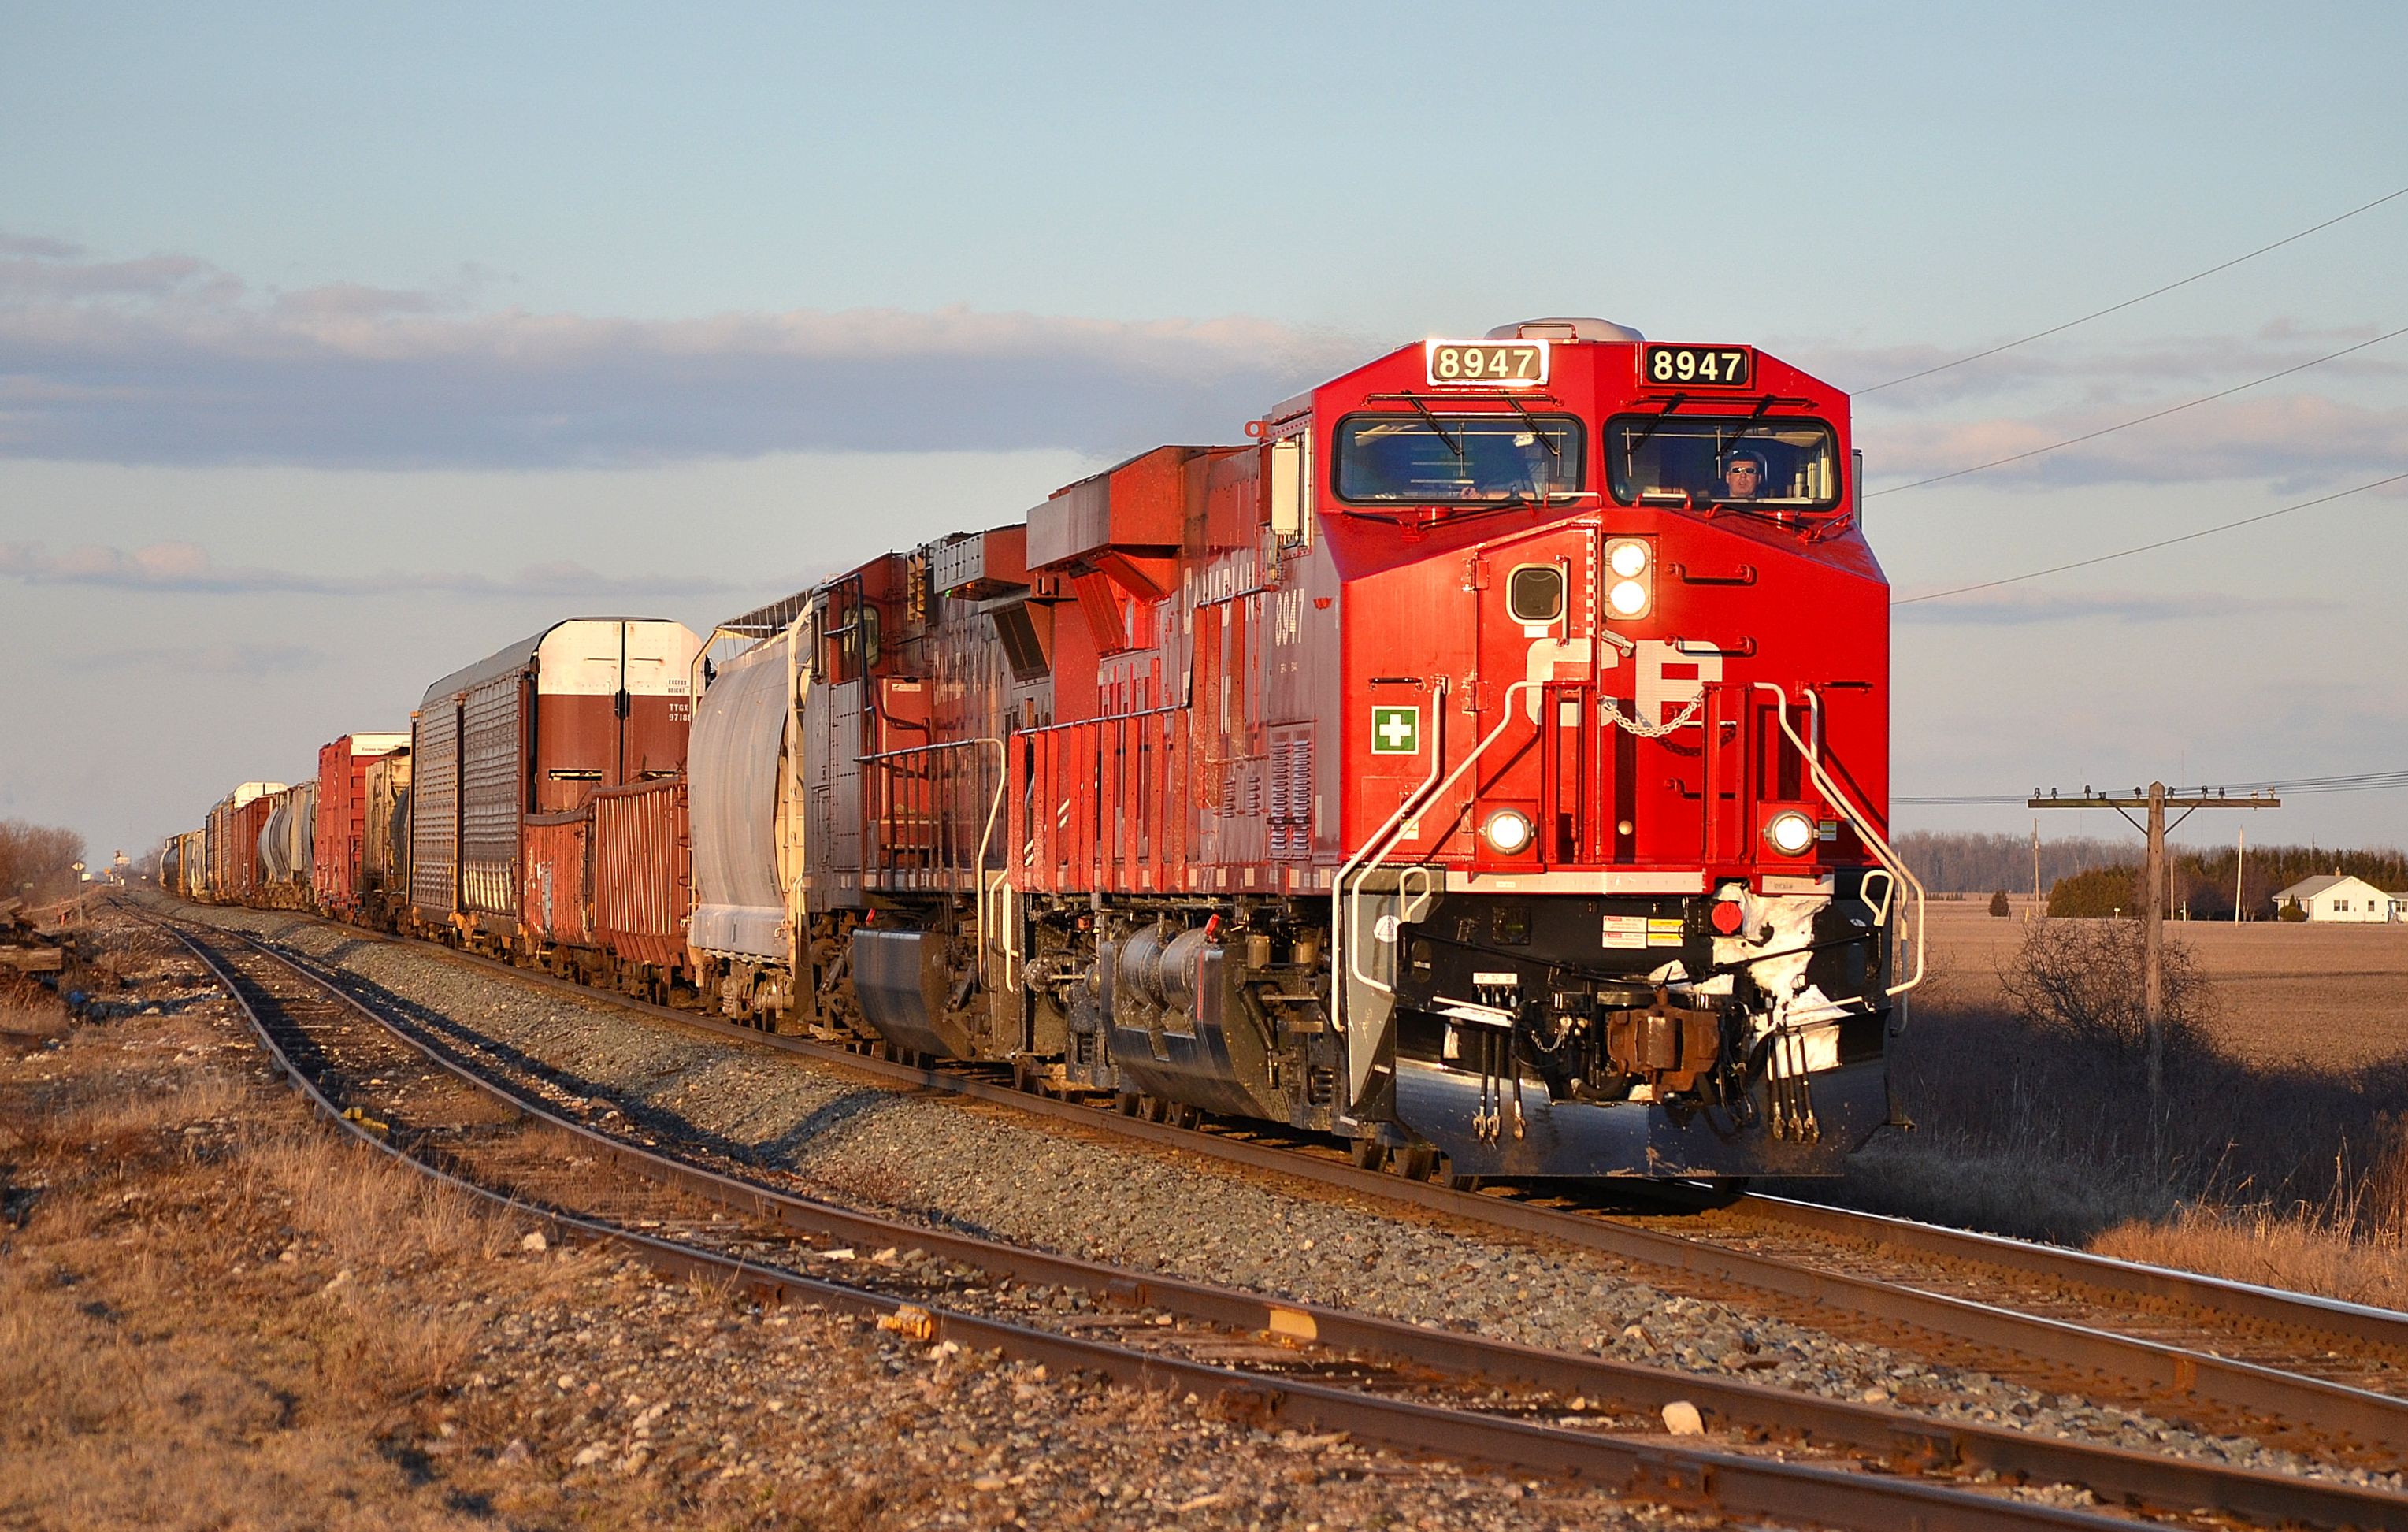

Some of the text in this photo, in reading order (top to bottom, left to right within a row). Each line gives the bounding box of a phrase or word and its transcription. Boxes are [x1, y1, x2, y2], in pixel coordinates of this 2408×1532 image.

[1438, 348, 1534, 378] 8947
[1653, 351, 1742, 383] 8947
[1275, 588, 1305, 647] 8947
[1526, 638, 1723, 730] CP
[669, 703, 688, 712] TTGX
